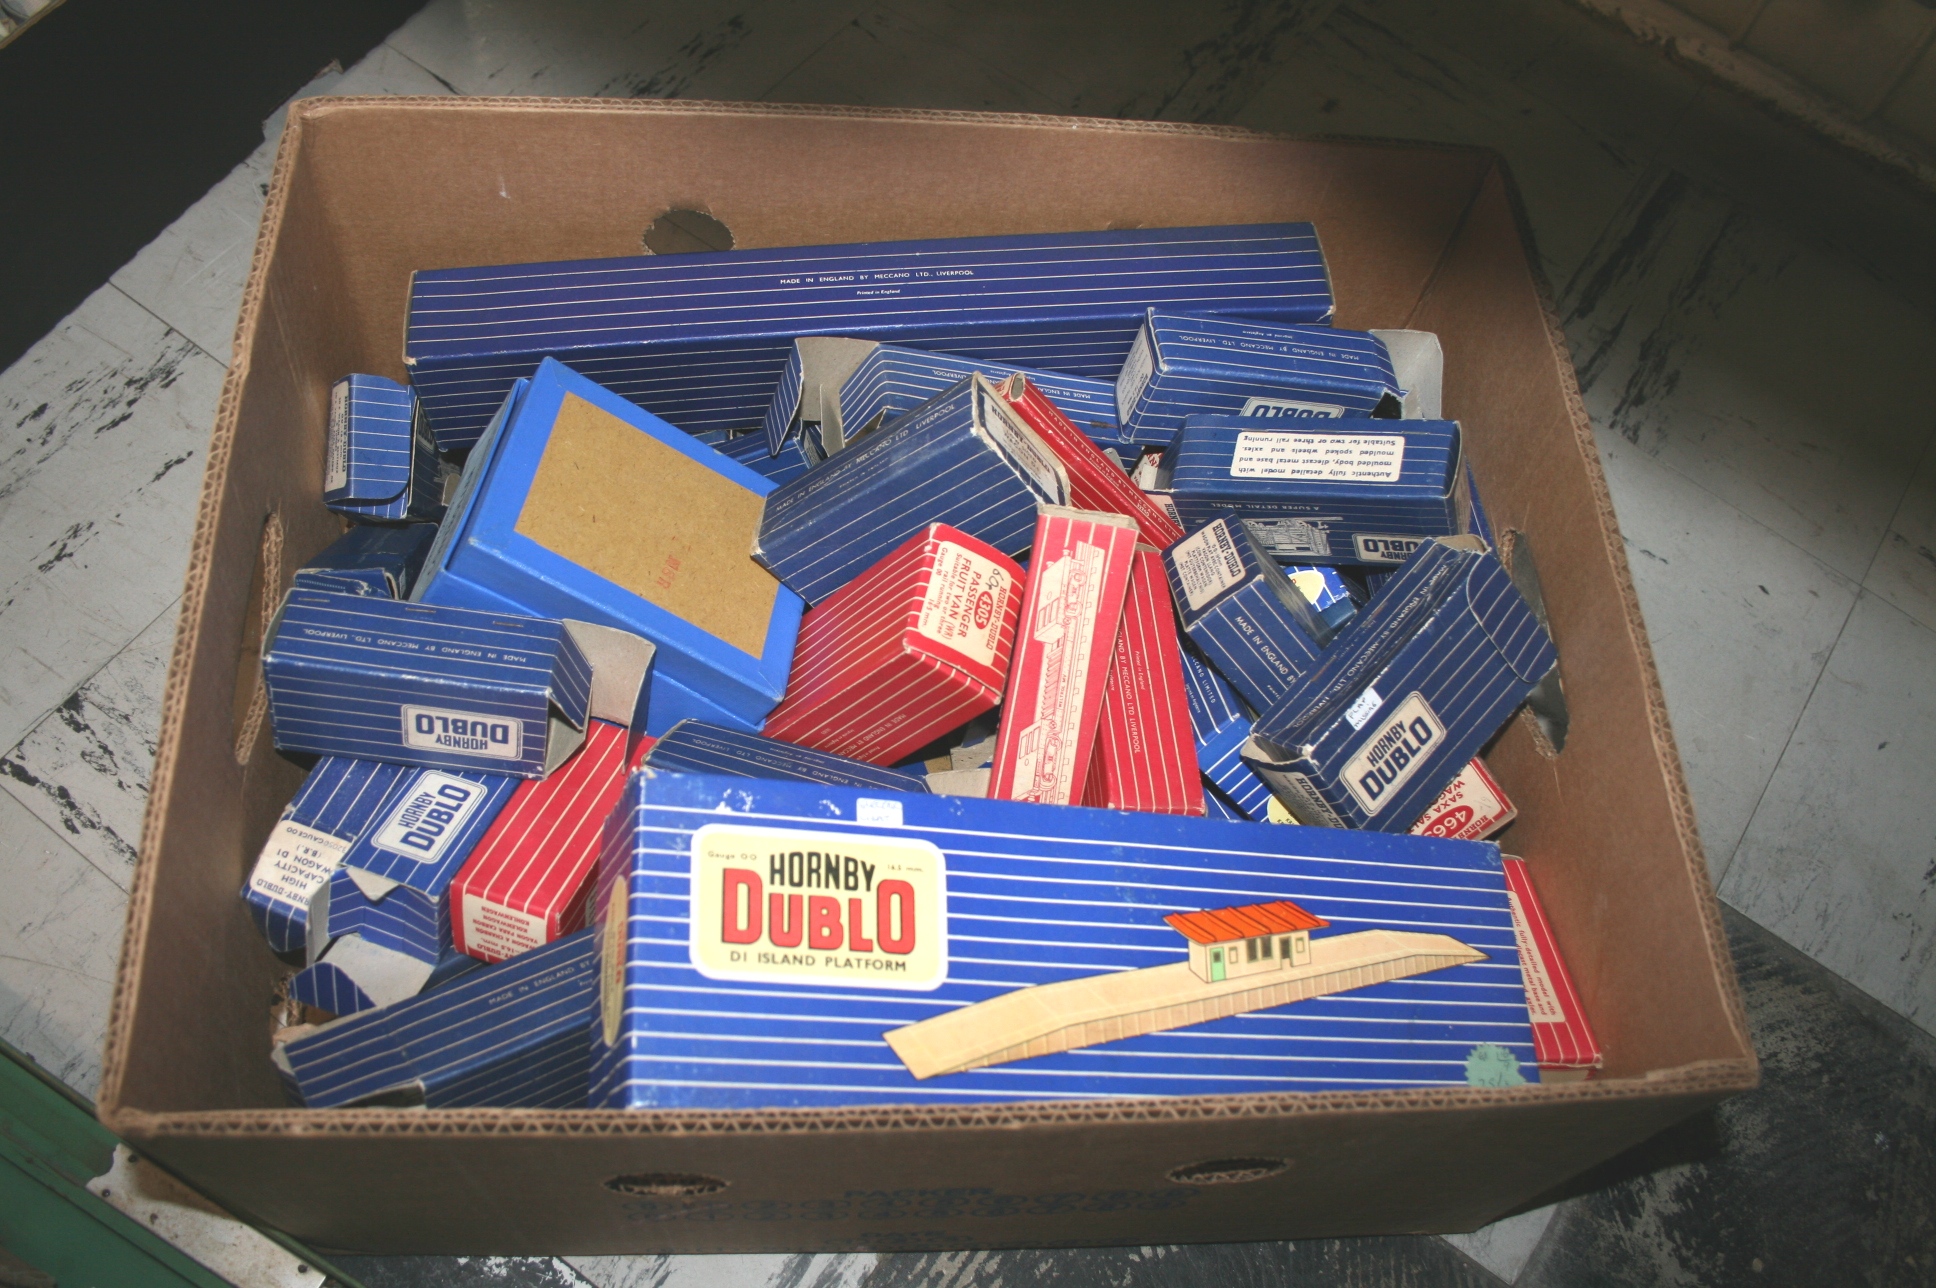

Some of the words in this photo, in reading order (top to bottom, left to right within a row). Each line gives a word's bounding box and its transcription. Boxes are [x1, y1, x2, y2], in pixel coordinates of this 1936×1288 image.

[1179, 335, 1215, 344] LIVERPOOL
[1240, 342, 1273, 350] MECCANO
[1292, 347, 1324, 356] ENGLAND
[1037, 387, 1060, 395] ENGLA
[776, 497, 794, 511] MADE
[797, 490, 805, 498] IN
[808, 471, 841, 492] ENGLAND
[855, 438, 892, 464] MECCANO
[895, 430, 908, 440] LTD
[915, 404, 955, 429] LIVERPOOL
[1048, 411, 1067, 431] MADE
[1070, 432, 1078, 442] IN
[1081, 444, 1115, 478] ENGLAND
[1118, 480, 1126, 488] BY
[1128, 490, 1162, 523] MECCANO
[1362, 536, 1418, 557] UBLO
[950, 553, 962, 579] Suitable
[958, 558, 971, 593] FRUIT
[934, 584, 946, 609] running
[950, 595, 962, 621] VAN
[958, 571, 982, 638] PASSENGER
[942, 606, 948, 615] or
[977, 593, 990, 626] 4305
[986, 586, 1007, 650] HORNBY-DUBLO
[303, 628, 347, 639] LIVERPOOL
[937, 615, 946, 635] three
[377, 638, 418, 649] MECCANO
[425, 643, 436, 651] BY
[442, 646, 481, 657] ENGLAND
[1235, 616, 1254, 635] MADE
[1252, 635, 1263, 645] IN
[1261, 645, 1288, 674] ENGLAND
[1287, 675, 1296, 683] BY
[503, 654, 526, 662] MADE
[1120, 656, 1126, 664] BY
[1122, 666, 1132, 700] MECCANO
[1127, 702, 1135, 715] LTD
[415, 713, 509, 744] DUBLO
[1130, 718, 1140, 753] LIVERPOOL
[435, 734, 488, 750] HORNBY
[837, 742, 856, 757] MECCAN
[1366, 721, 1407, 767] HORNBY
[1359, 716, 1433, 801] DUBLO
[398, 791, 436, 829] HORNBY
[1295, 777, 1343, 828] HORNBY-DU
[1433, 791, 1463, 814] SAXA
[399, 784, 471, 852] DUBLO
[1455, 815, 1489, 839] HORNB
[294, 855, 334, 873] WAGON
[708, 851, 735, 861] Gauge
[274, 860, 324, 884] CAPACITY
[281, 875, 307, 890] HIGH
[769, 851, 875, 892] HORNBY
[256, 878, 310, 905] RNBY-DUBLO
[722, 868, 916, 955] DUBLO
[758, 952, 816, 967] ISLAND
[825, 956, 906, 972] PLATFORM
[489, 991, 513, 1005] MADE
[518, 984, 529, 992] IN
[533, 967, 575, 987] ENGLAND
[579, 960, 591, 968] BY
[1524, 967, 1536, 986] metal
[1530, 986, 1542, 1003] base
[1537, 1003, 1547, 1016] and
[1536, 976, 1550, 998] model
[1546, 1000, 1556, 1016] with
